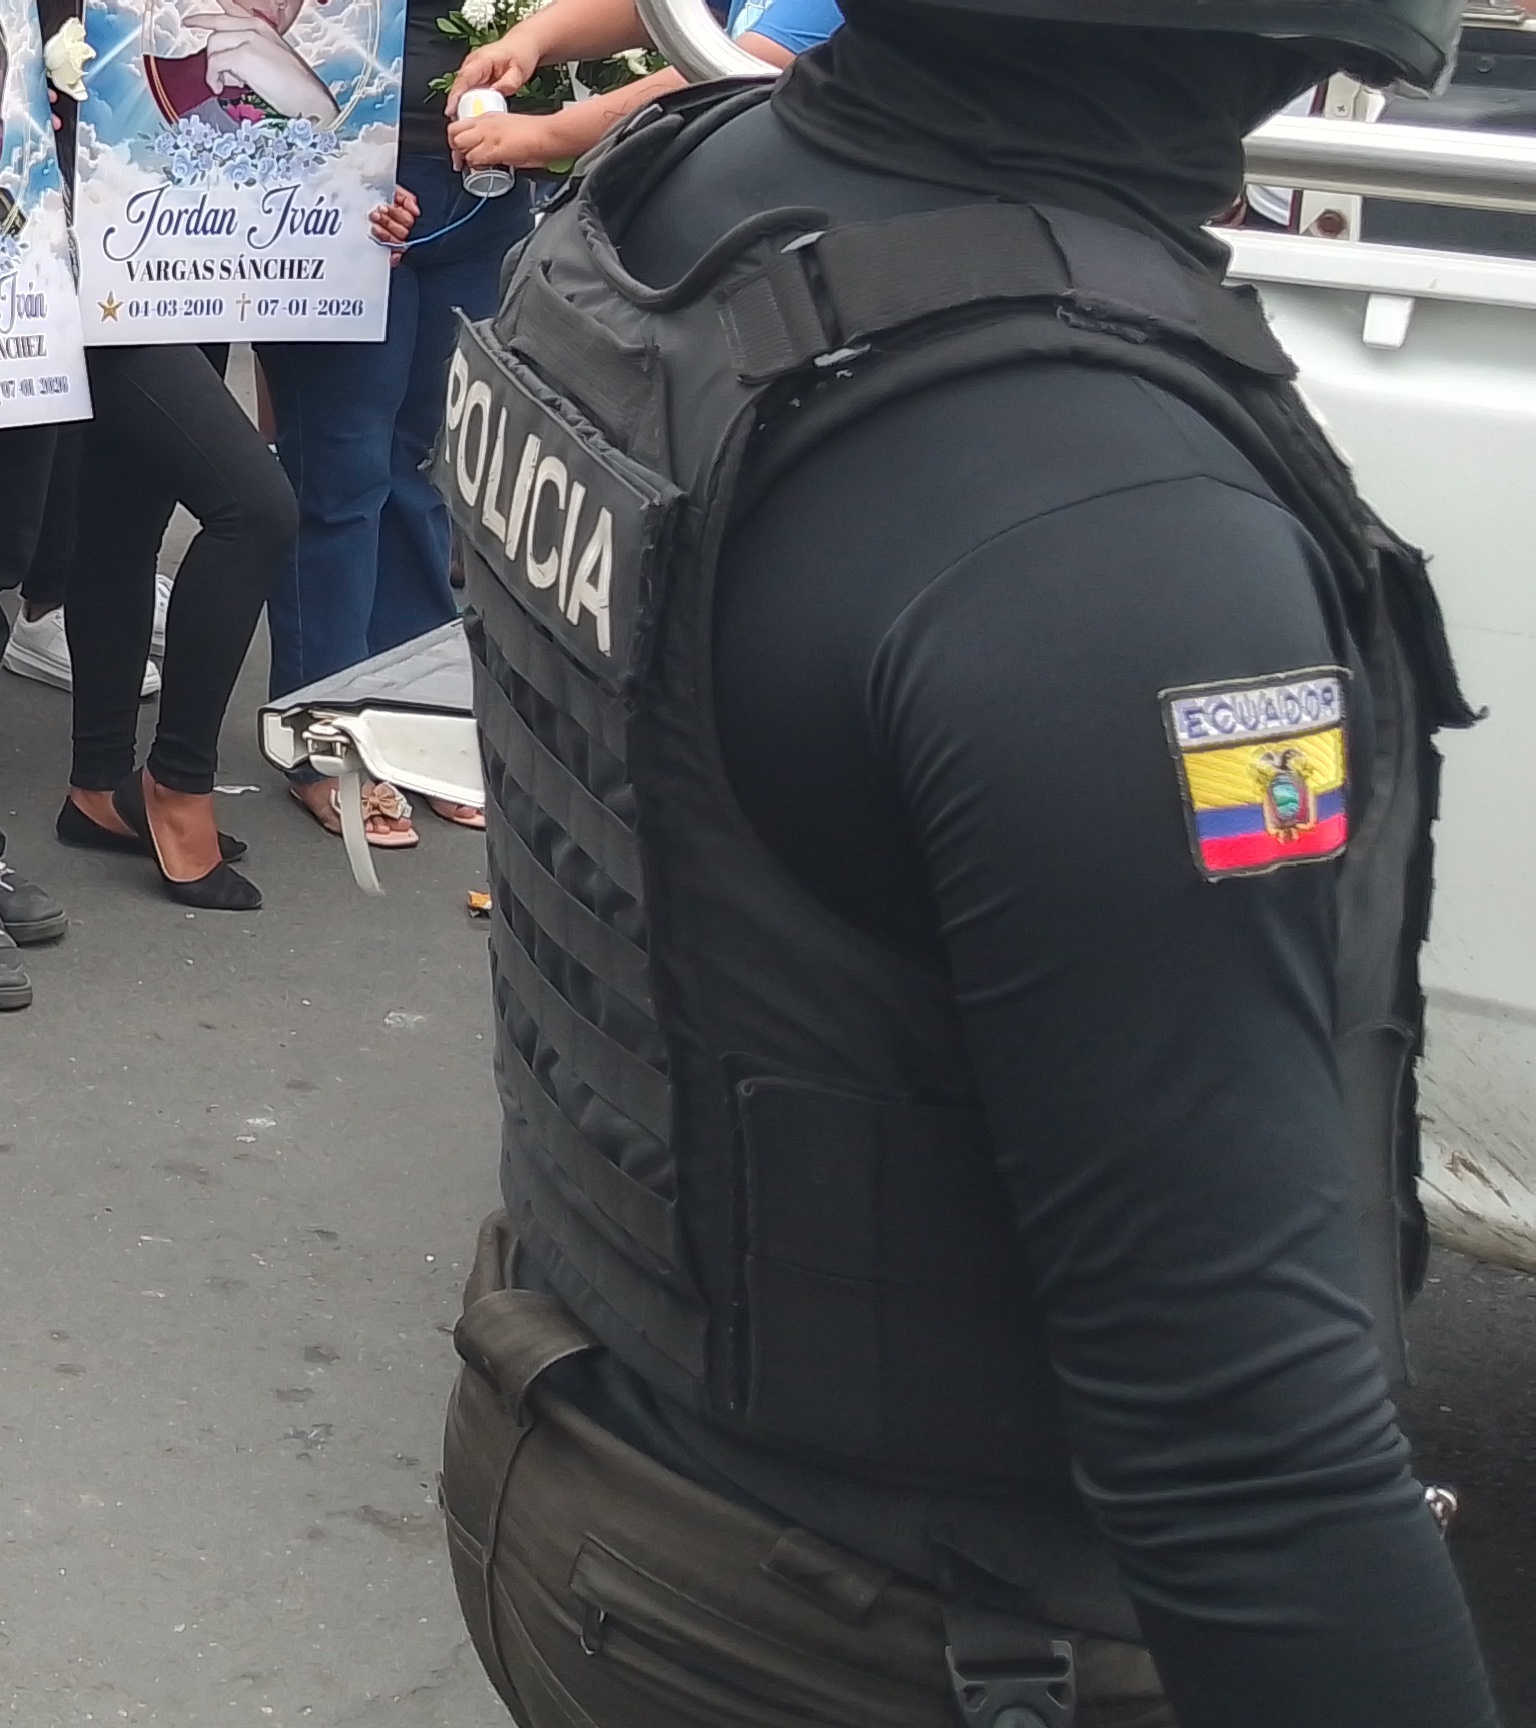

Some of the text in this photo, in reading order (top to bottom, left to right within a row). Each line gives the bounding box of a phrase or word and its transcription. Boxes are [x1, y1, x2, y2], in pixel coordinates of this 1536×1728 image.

[103, 183, 342, 261] Jordan Iván
[127, 253, 326, 282] VARGAS SÁNCHEZ
[128, 298, 364, 317] 04-03-2010 07-01-2026
[445, 346, 613, 658] POLICIA
[1178, 683, 1335, 739] ECUADOR
